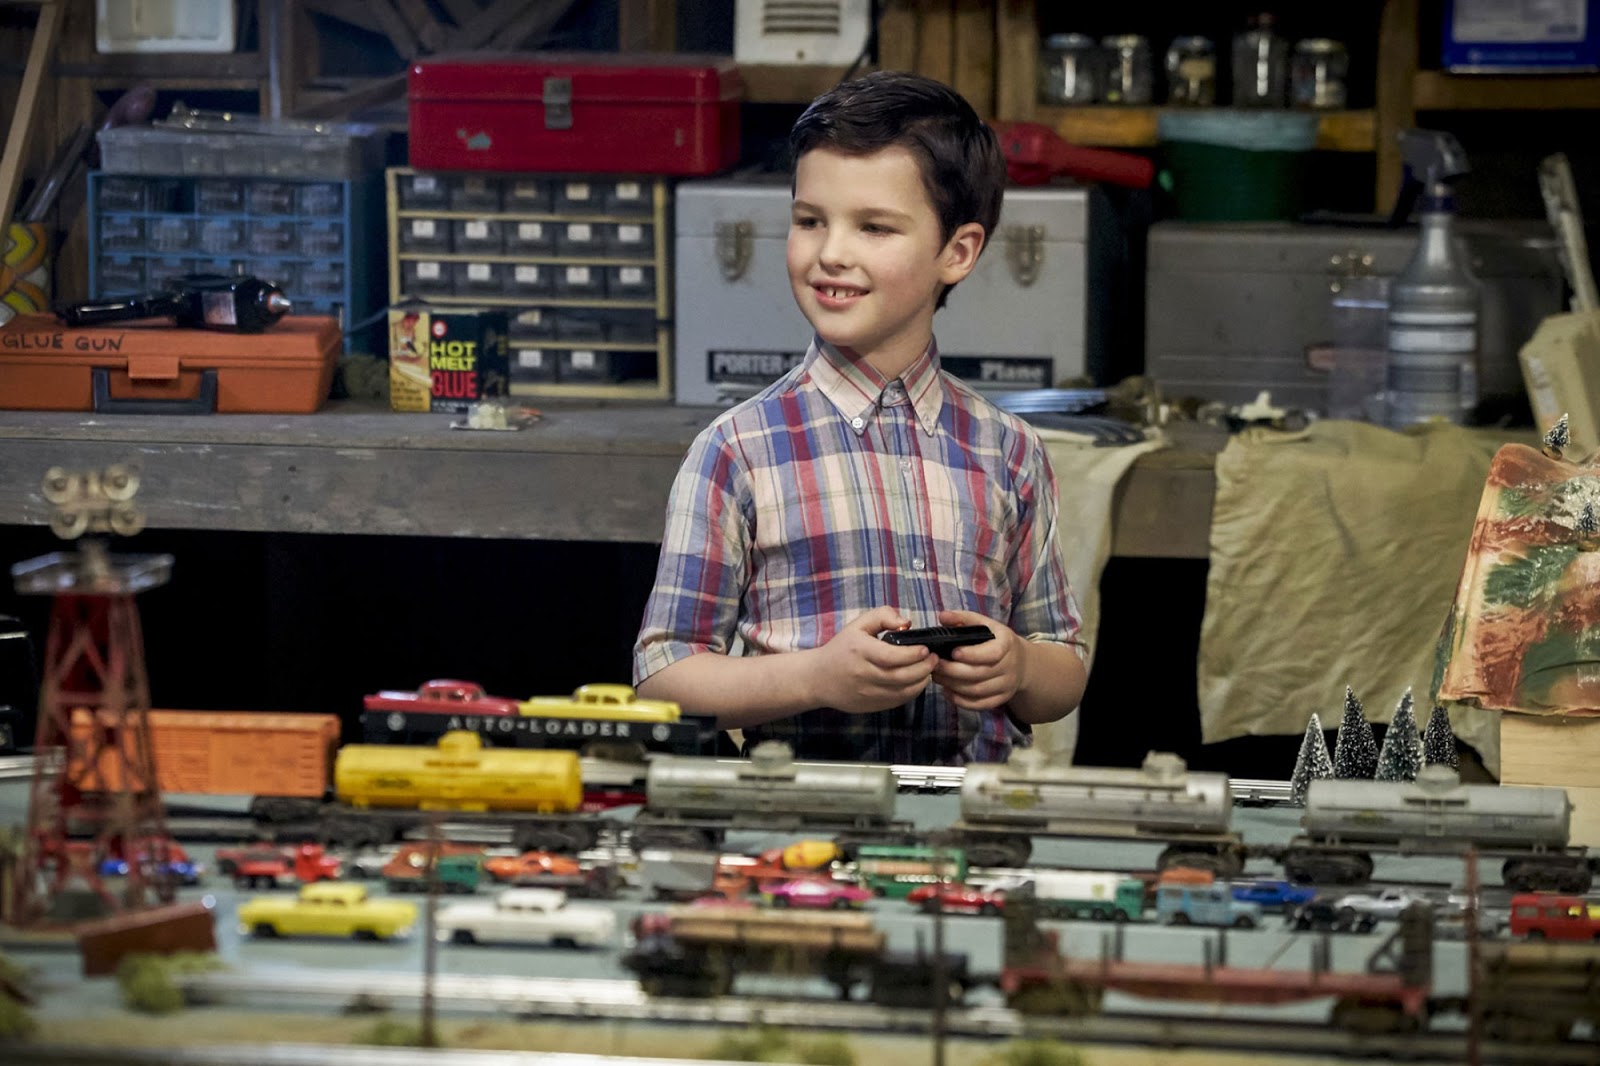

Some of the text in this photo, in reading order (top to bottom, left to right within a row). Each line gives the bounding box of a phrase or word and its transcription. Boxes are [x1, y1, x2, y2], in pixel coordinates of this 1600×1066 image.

[2, 331, 125, 351] GLUE GUN
[430, 341, 476, 357] HOT
[430, 357, 475, 370] MELT
[431, 371, 477, 398] GLUE
[448, 715, 630, 737] AUTO-LOADER
